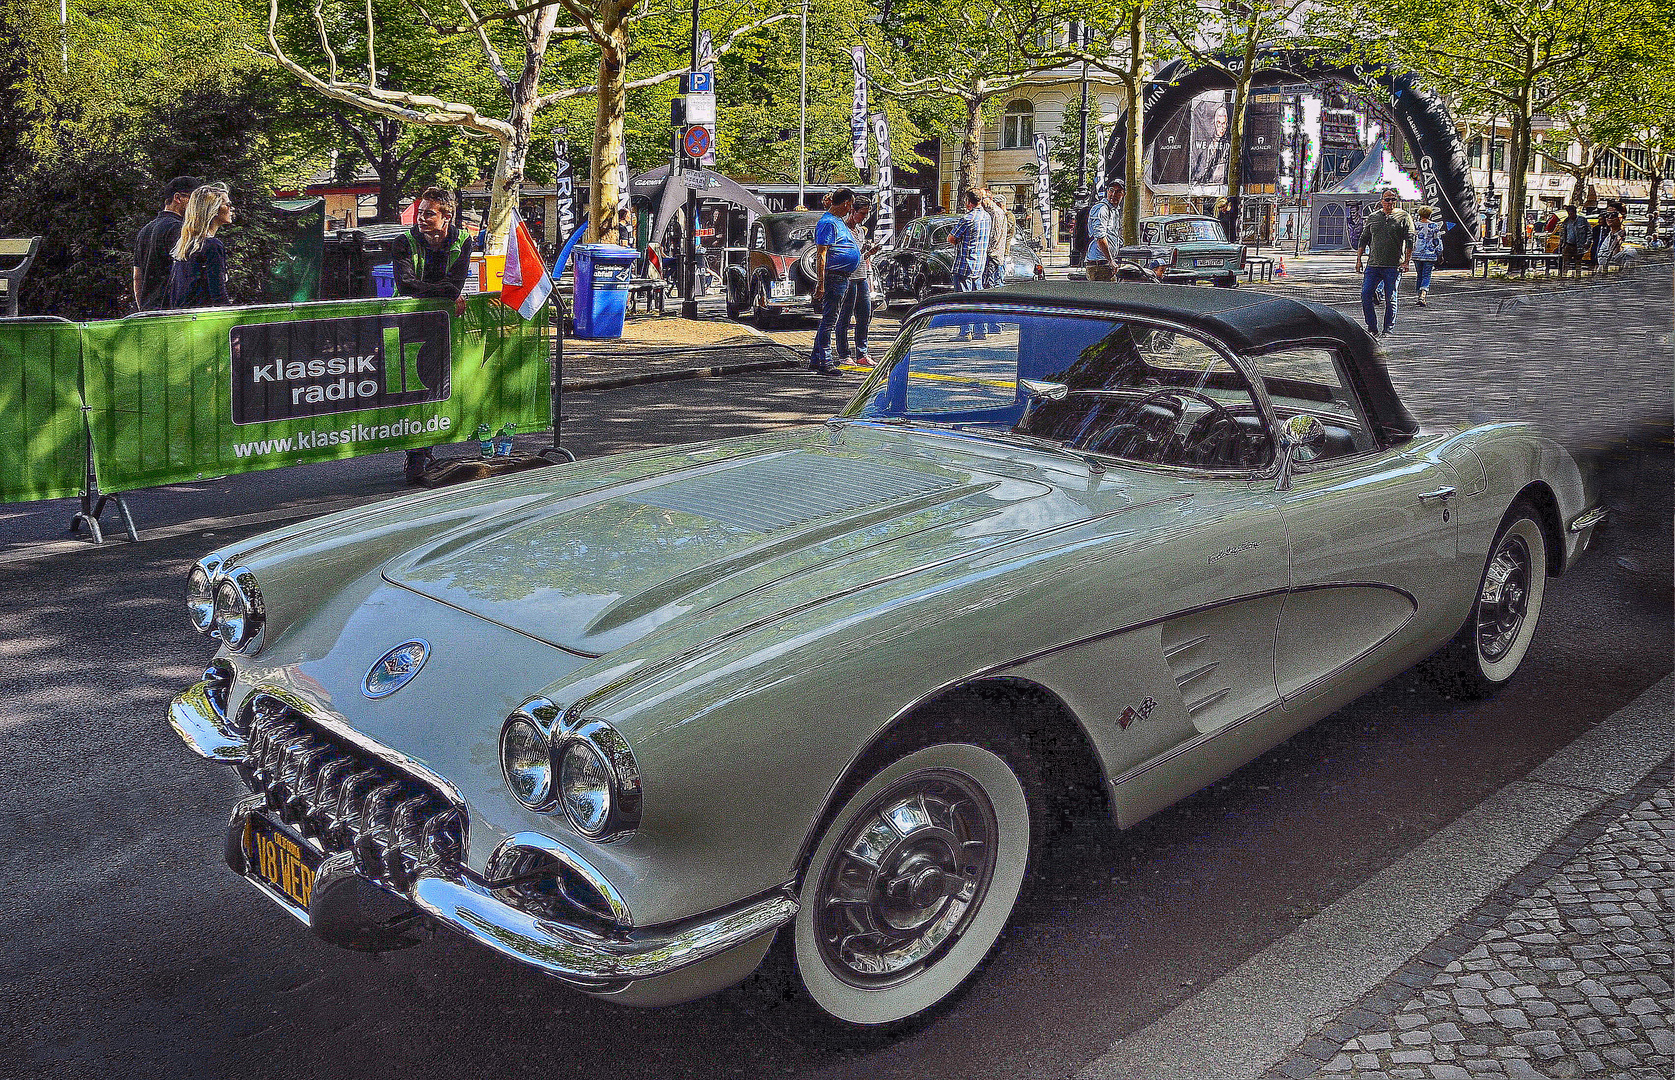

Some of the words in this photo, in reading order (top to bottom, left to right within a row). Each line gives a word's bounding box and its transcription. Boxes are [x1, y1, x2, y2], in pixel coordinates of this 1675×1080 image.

[694, 73, 706, 90] P
[875, 119, 896, 251] GARMIN
[233, 414, 451, 458] www.klassikradio.de
[256, 832, 278, 883] V8
[280, 848, 315, 907] WER
